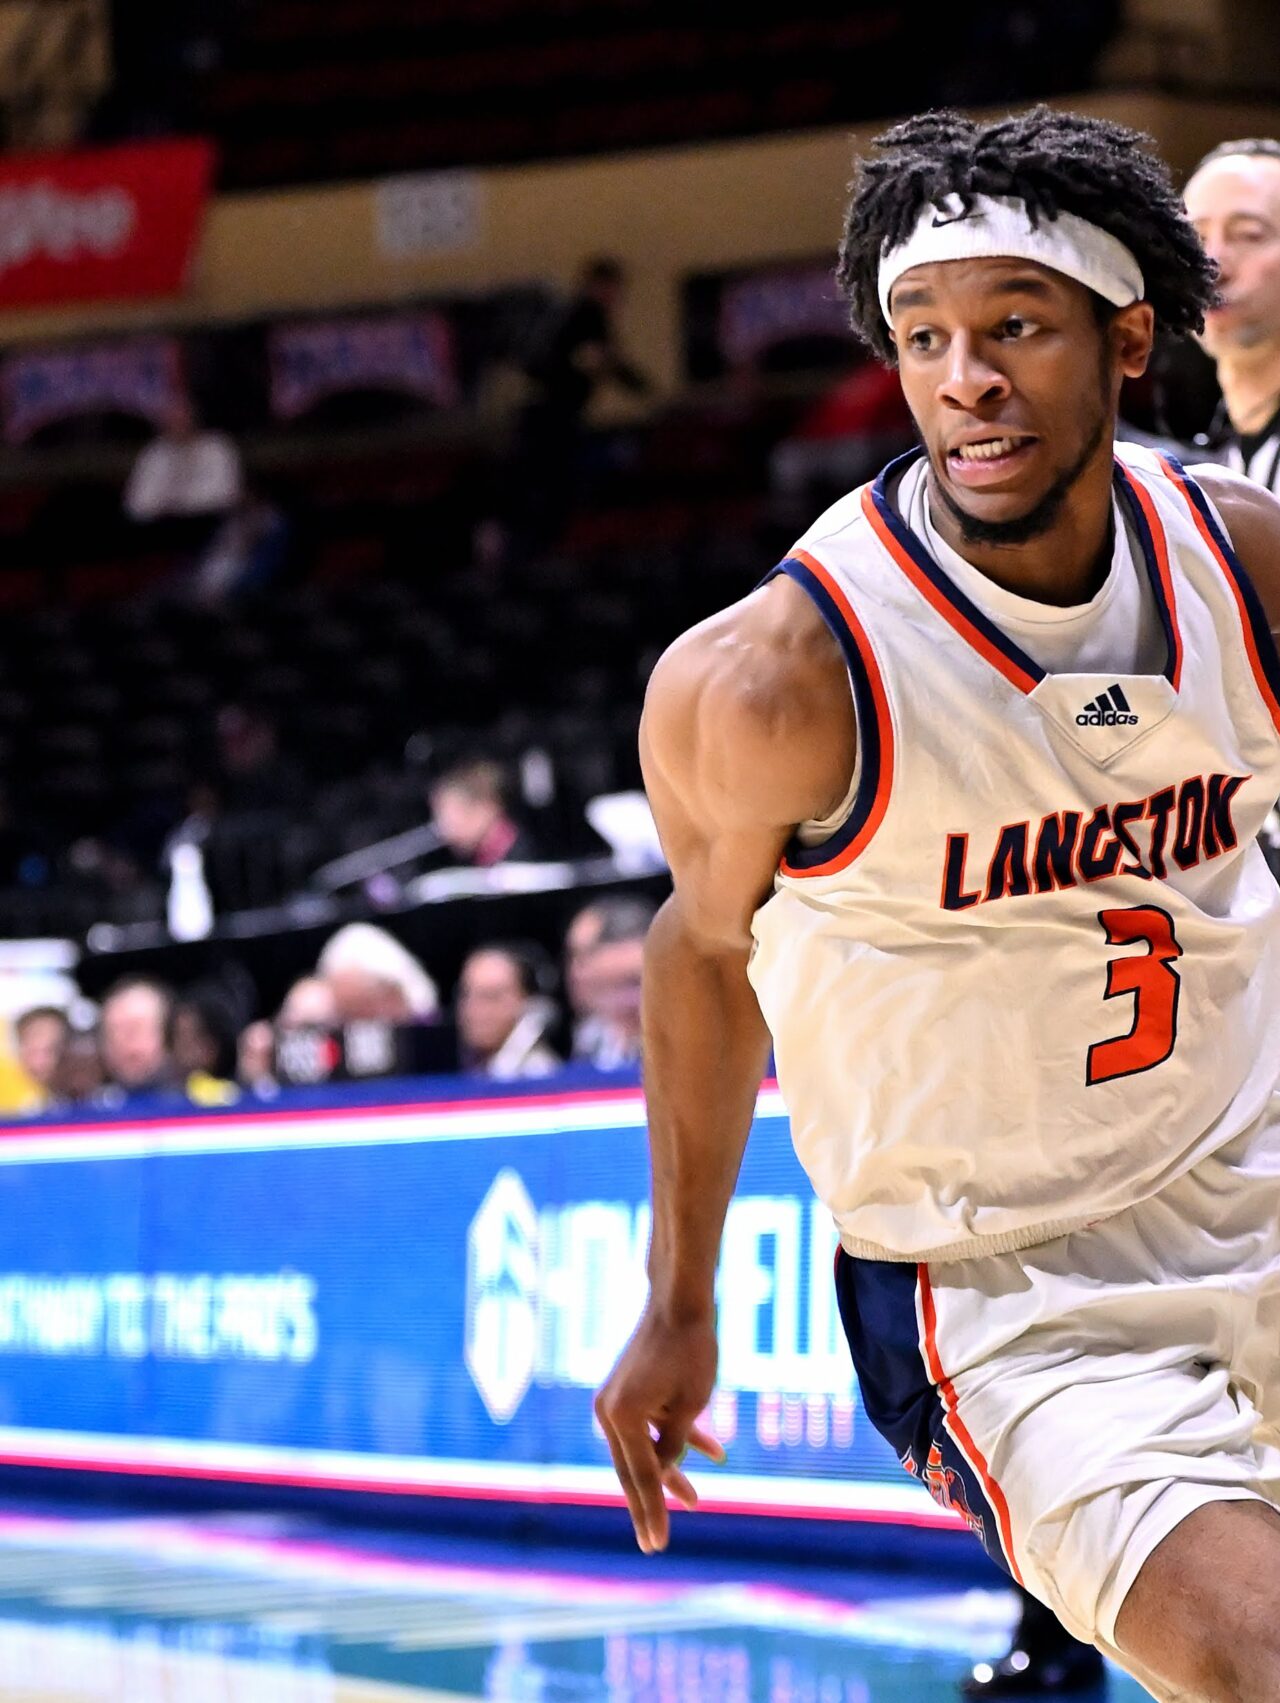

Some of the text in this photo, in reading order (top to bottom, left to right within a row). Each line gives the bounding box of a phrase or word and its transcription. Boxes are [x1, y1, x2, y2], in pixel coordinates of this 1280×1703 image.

[1075, 710, 1139, 728] adidas
[940, 773, 1253, 911] LANGSTON
[1085, 904, 1184, 1087] 3
